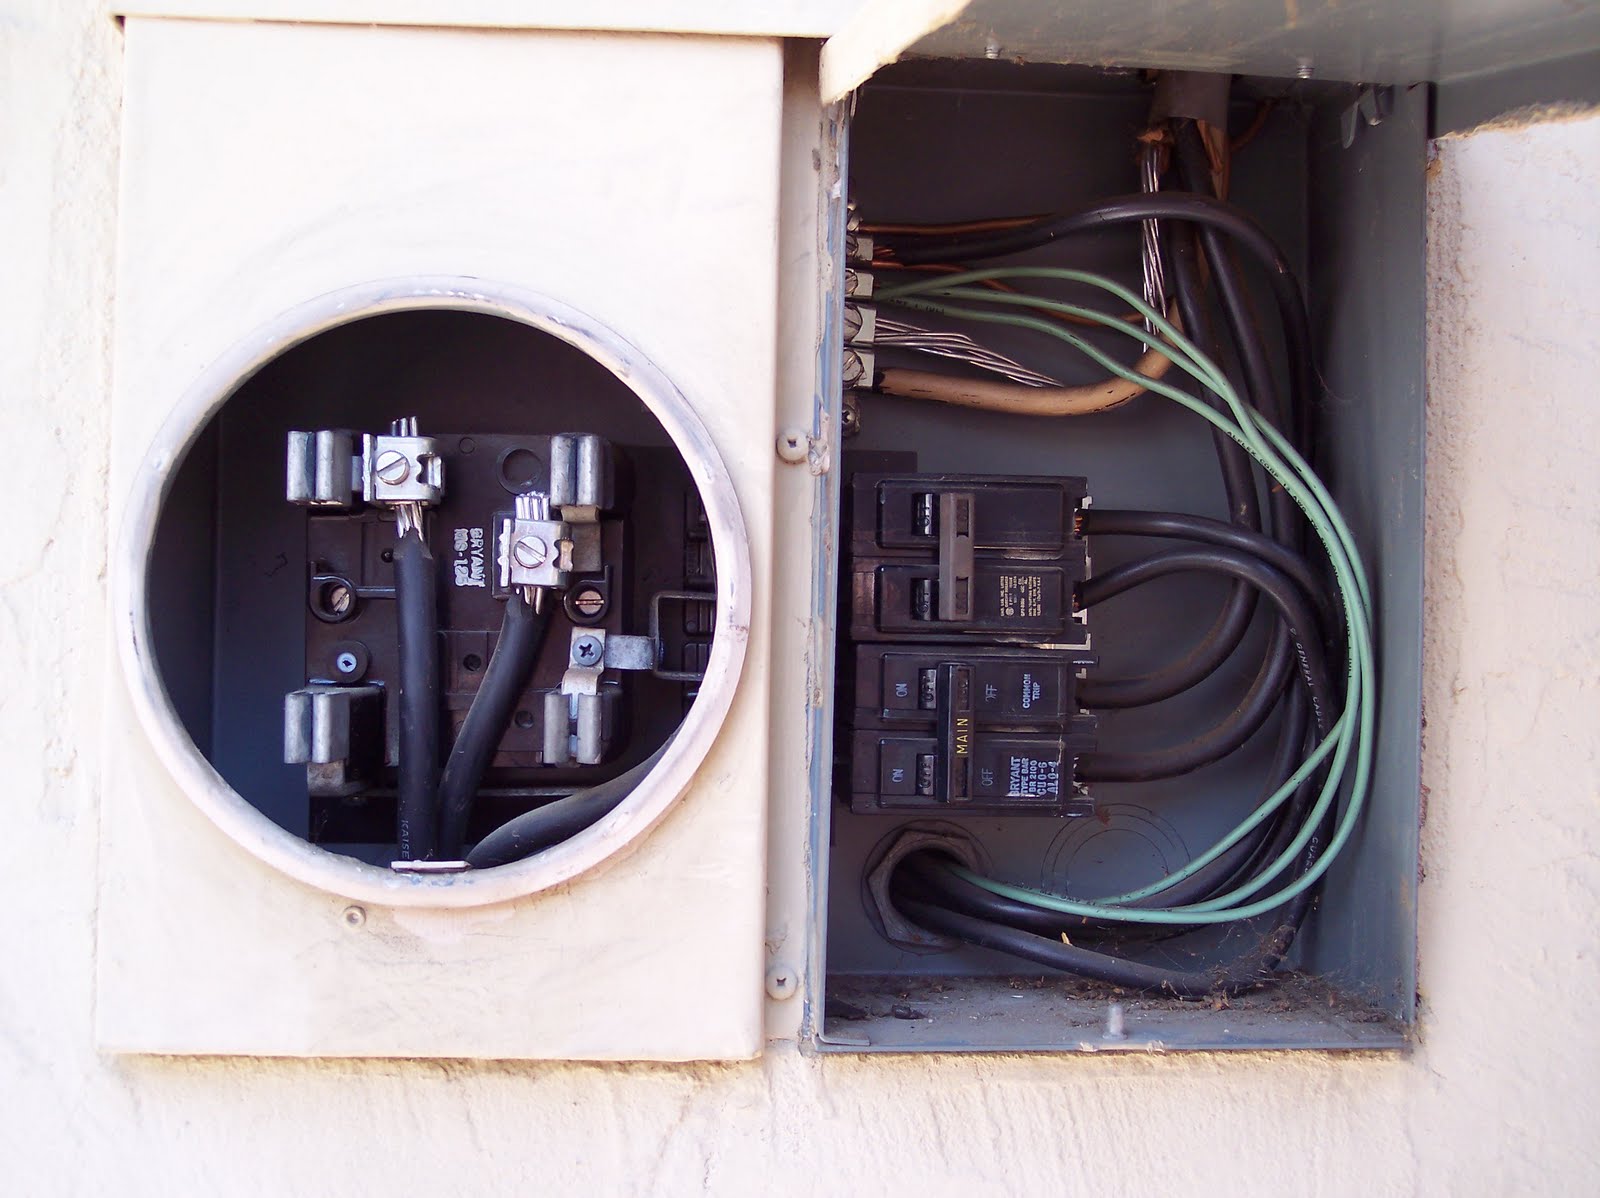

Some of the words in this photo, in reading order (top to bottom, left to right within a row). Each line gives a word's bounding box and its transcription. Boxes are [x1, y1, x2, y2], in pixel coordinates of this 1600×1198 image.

[469, 527, 486, 587] BRYANT
[895, 683, 908, 697] ON
[1022, 673, 1031, 709] COMMON
[1032, 681, 1041, 701] TRIP
[956, 717, 968, 754] MAIN
[892, 769, 905, 783] ON
[981, 767, 994, 787] OFF
[1010, 756, 1021, 796] BRYANT
[1029, 760, 1038, 780] 2100
[1029, 781, 1037, 793] BR
[1037, 781, 1047, 795] CU
